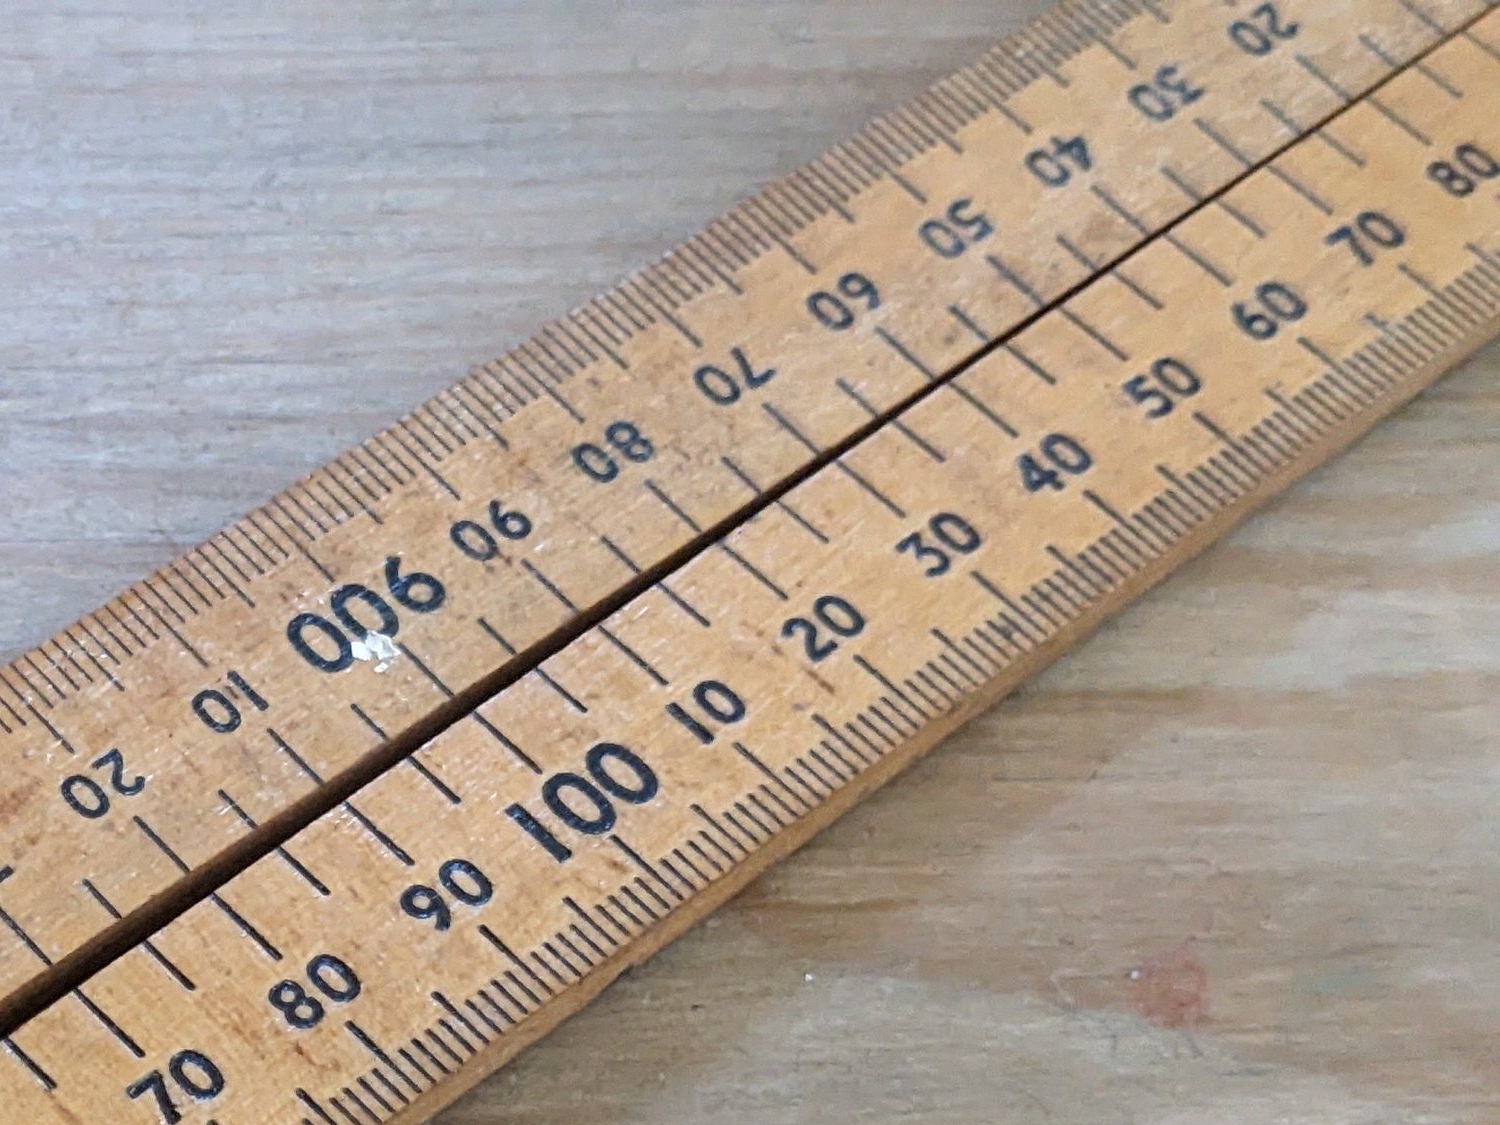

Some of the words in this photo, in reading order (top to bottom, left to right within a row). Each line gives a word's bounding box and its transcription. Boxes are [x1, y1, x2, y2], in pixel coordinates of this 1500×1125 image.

[1226, 2, 1300, 57] 20
[1126, 65, 1203, 122] 30
[1023, 135, 1095, 188] 40
[917, 199, 995, 259] 50
[804, 272, 882, 332] 60
[691, 346, 776, 406] 70
[570, 420, 655, 483] 80
[448, 500, 533, 562] 90
[125, 1048, 225, 1125] 70
[267, 953, 361, 1030] 80
[399, 858, 494, 932] 90
[505, 742, 659, 864] 100
[667, 680, 747, 745] 10
[781, 594, 866, 664] 20
[895, 510, 983, 578] 30
[1017, 433, 1093, 494] 40
[1121, 356, 1201, 420] 50
[1230, 282, 1308, 341] 60
[1323, 210, 1406, 267] 70
[1426, 144, 1500, 198] 80
[286, 556, 447, 674] 900
[190, 670, 269, 734] 10
[58, 748, 146, 819] 20
